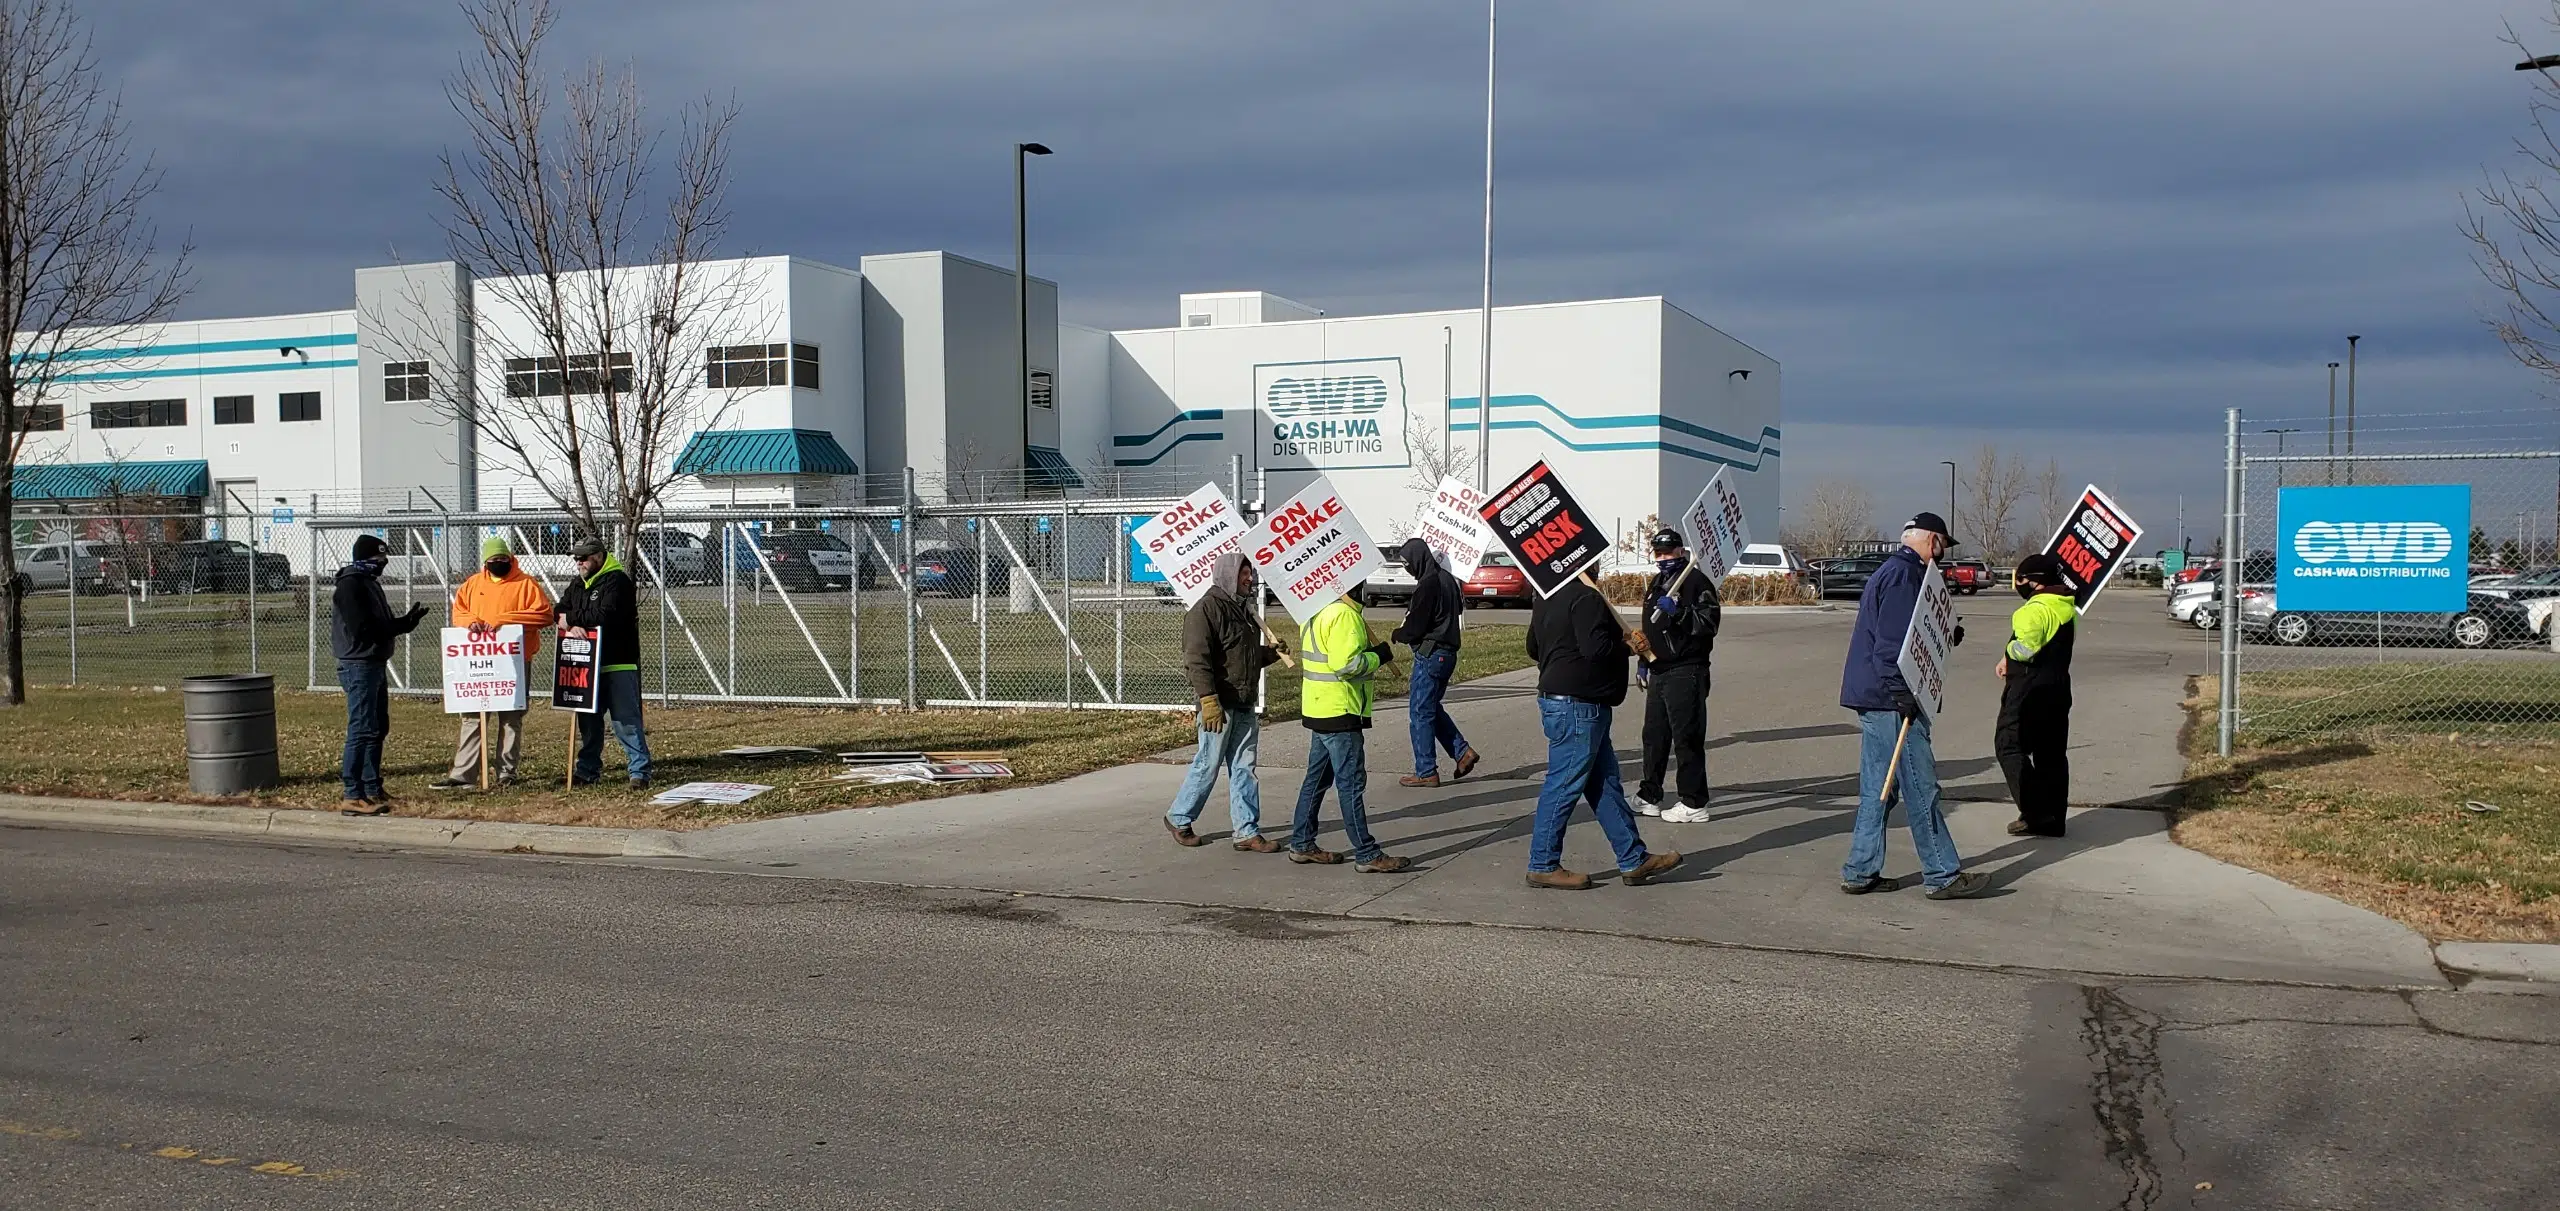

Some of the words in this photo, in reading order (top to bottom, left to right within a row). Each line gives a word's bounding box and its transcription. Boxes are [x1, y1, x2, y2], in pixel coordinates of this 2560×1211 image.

[1267, 376, 1387, 418] CWD
[1273, 419, 1380, 440] CASH-WA
[166, 445, 174, 455] 12
[231, 443, 239, 452] 11
[1273, 439, 1382, 456] DISTRIBUTING
[1460, 488, 1485, 505] ON
[1518, 474, 1535, 494] ALERT
[1162, 501, 1195, 525] ON
[1269, 500, 1308, 534] ON
[1437, 511, 1477, 538] Cash-WA
[1510, 521, 1530, 539] PUTS
[1526, 496, 1561, 525] WORKERS
[1715, 479, 1743, 555] STRIKE
[1729, 492, 1743, 524] ON
[1149, 499, 1226, 553] STRIKE
[1176, 520, 1229, 556] Cash-WA
[1255, 496, 1343, 566] STRIKE
[1420, 521, 1480, 559] TEAMSTERS
[1520, 509, 1583, 566] RISK
[1697, 500, 1726, 577] TEAMSTERS
[1716, 513, 1728, 541] HJH
[2073, 521, 2088, 538] PUTS
[2085, 533, 2111, 560] WORKERS
[2081, 509, 2119, 549] CWD
[2293, 521, 2452, 564] CWD
[1284, 528, 1342, 572] Cash-WA
[1454, 551, 1472, 566] 120
[1561, 544, 1588, 568] STRIKE
[1693, 512, 1710, 556] LOCAL
[1709, 555, 1720, 579] 120
[2056, 533, 2103, 585] RISK
[1183, 563, 1215, 590] LOC
[1288, 541, 1360, 595] TEAMSTERS
[1297, 571, 1338, 602] LOCAL
[1339, 551, 1362, 572] 120
[2293, 567, 2359, 577] CASH-WA
[2360, 567, 2451, 578] DISTRIBUTING
[1924, 584, 1954, 653] STRIKE
[1939, 587, 1952, 620] ON
[446, 642, 520, 657] STRIKE
[467, 630, 497, 642] ON
[1923, 614, 1944, 661] Cash-WA
[469, 660, 493, 669] HJH
[1910, 642, 1928, 682] LOCAL
[1928, 679, 1938, 701] 120
[1912, 624, 1943, 693] TEAMSTERS
[453, 680, 516, 690] TEAMSTERS
[456, 689, 490, 698] LOCAL
[494, 688, 513, 696] 120
[559, 666, 590, 688] RISK
[568, 694, 584, 702] STRIKE
